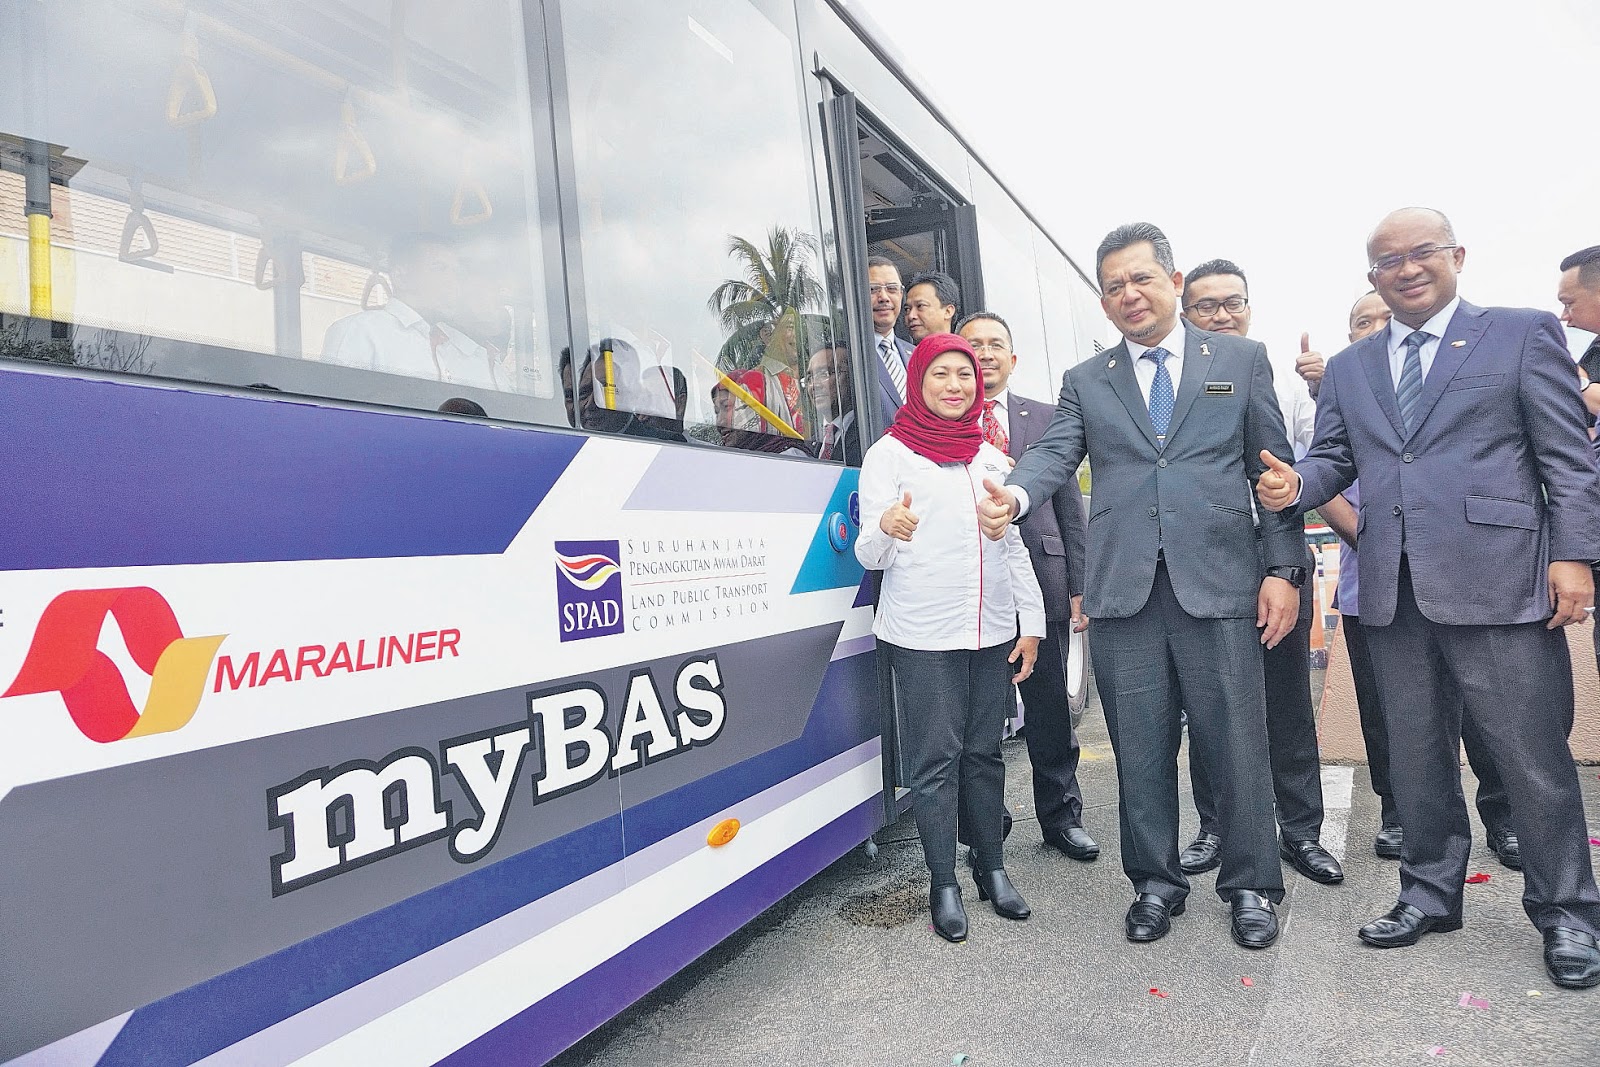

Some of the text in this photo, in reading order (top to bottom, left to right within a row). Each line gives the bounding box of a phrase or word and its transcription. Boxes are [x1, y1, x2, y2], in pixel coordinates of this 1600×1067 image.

[627, 538, 766, 555] SURUHANJAYA
[629, 554, 766, 576] PENGANGKUTAN AWAM DARAT
[631, 582, 768, 610] LAND PUBLIC TRANSPORT
[563, 599, 620, 633] SPAD
[632, 600, 769, 632] COMMISSION
[213, 628, 462, 694] MARALINER
[271, 654, 727, 892] myBAS
